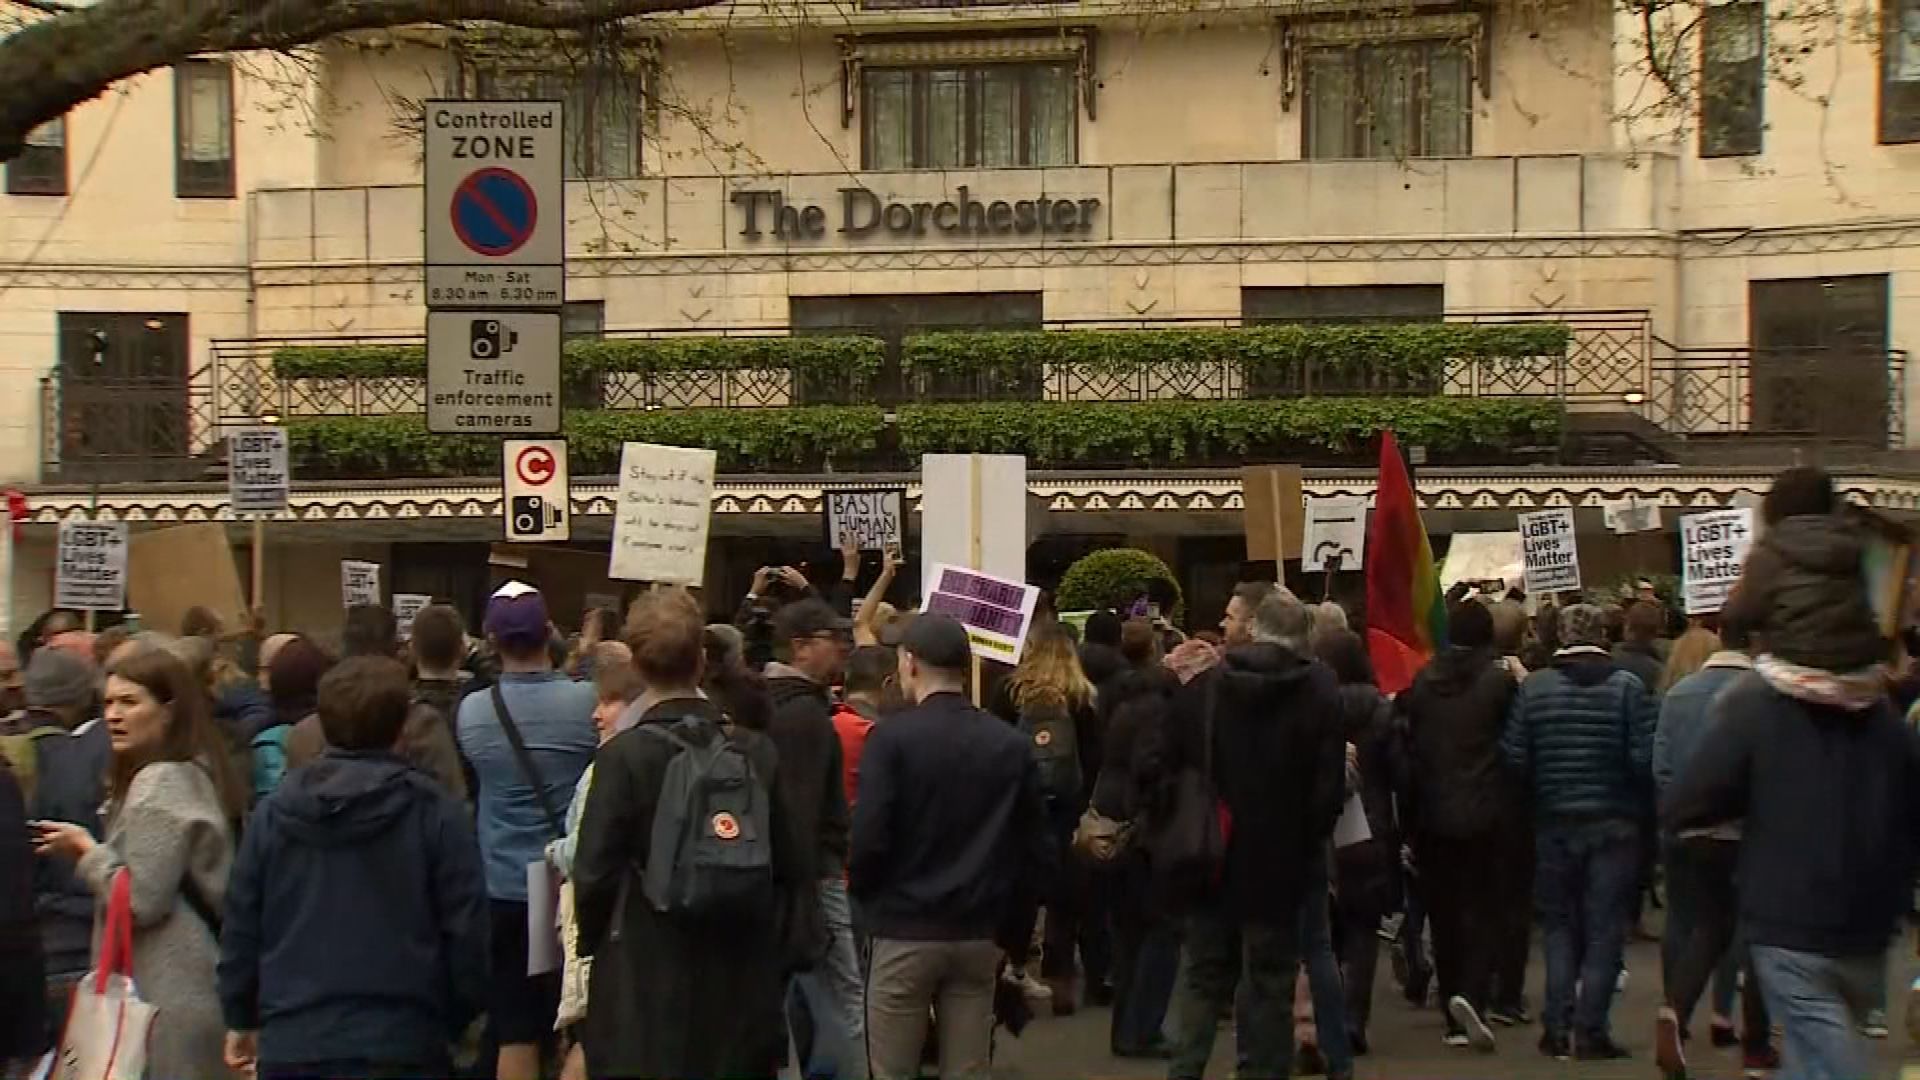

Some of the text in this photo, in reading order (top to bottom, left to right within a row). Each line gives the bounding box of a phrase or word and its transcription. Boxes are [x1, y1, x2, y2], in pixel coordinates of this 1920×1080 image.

[435, 110, 553, 129] Controlled
[452, 136, 535, 158] ZONE
[730, 185, 1101, 237] The Dorchester
[465, 271, 495, 283] Mon
[506, 271, 531, 284] Sat
[432, 287, 465, 299] 8.30
[468, 290, 489, 299] am
[536, 290, 558, 301] pm
[463, 369, 525, 385] Traffic
[435, 390, 553, 407] enforcement
[455, 413, 532, 427] cameras
[833, 492, 893, 516] BASIC
[838, 515, 897, 535] HUMAN
[1522, 519, 1570, 538] LGBT+
[1685, 522, 1749, 545] LGBT+
[1523, 538, 1561, 553] Lives
[1686, 545, 1734, 563] Lives
[1525, 551, 1574, 568] Matter
[1686, 562, 1741, 580] Matte
